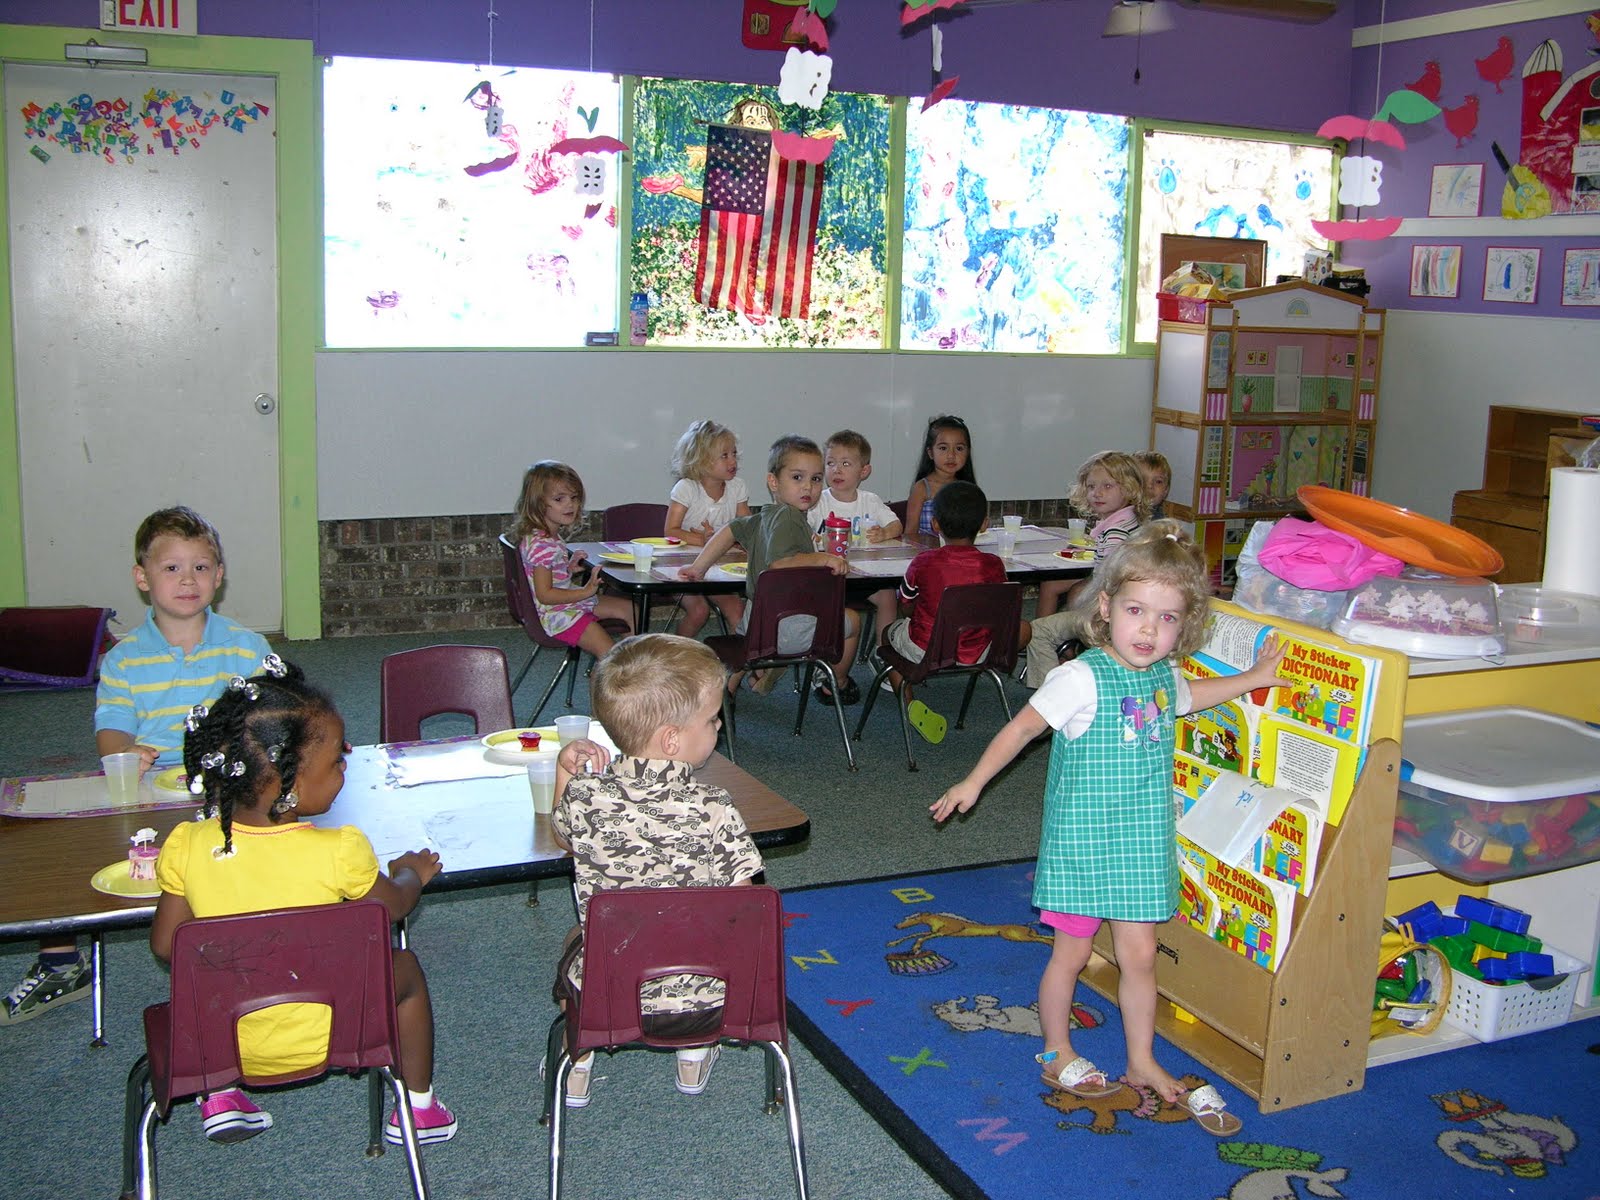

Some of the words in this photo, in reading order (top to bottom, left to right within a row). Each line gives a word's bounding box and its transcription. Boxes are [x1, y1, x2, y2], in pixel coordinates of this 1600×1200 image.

[119, 0, 179, 28] EXIT
[1281, 656, 1359, 691] DICTIONARY
[1292, 643, 1308, 661] My
[1310, 648, 1351, 671] Sticker
[1207, 871, 1274, 918] DICTIONARY
[1216, 860, 1230, 878] My
[1231, 867, 1265, 897] Sticker
